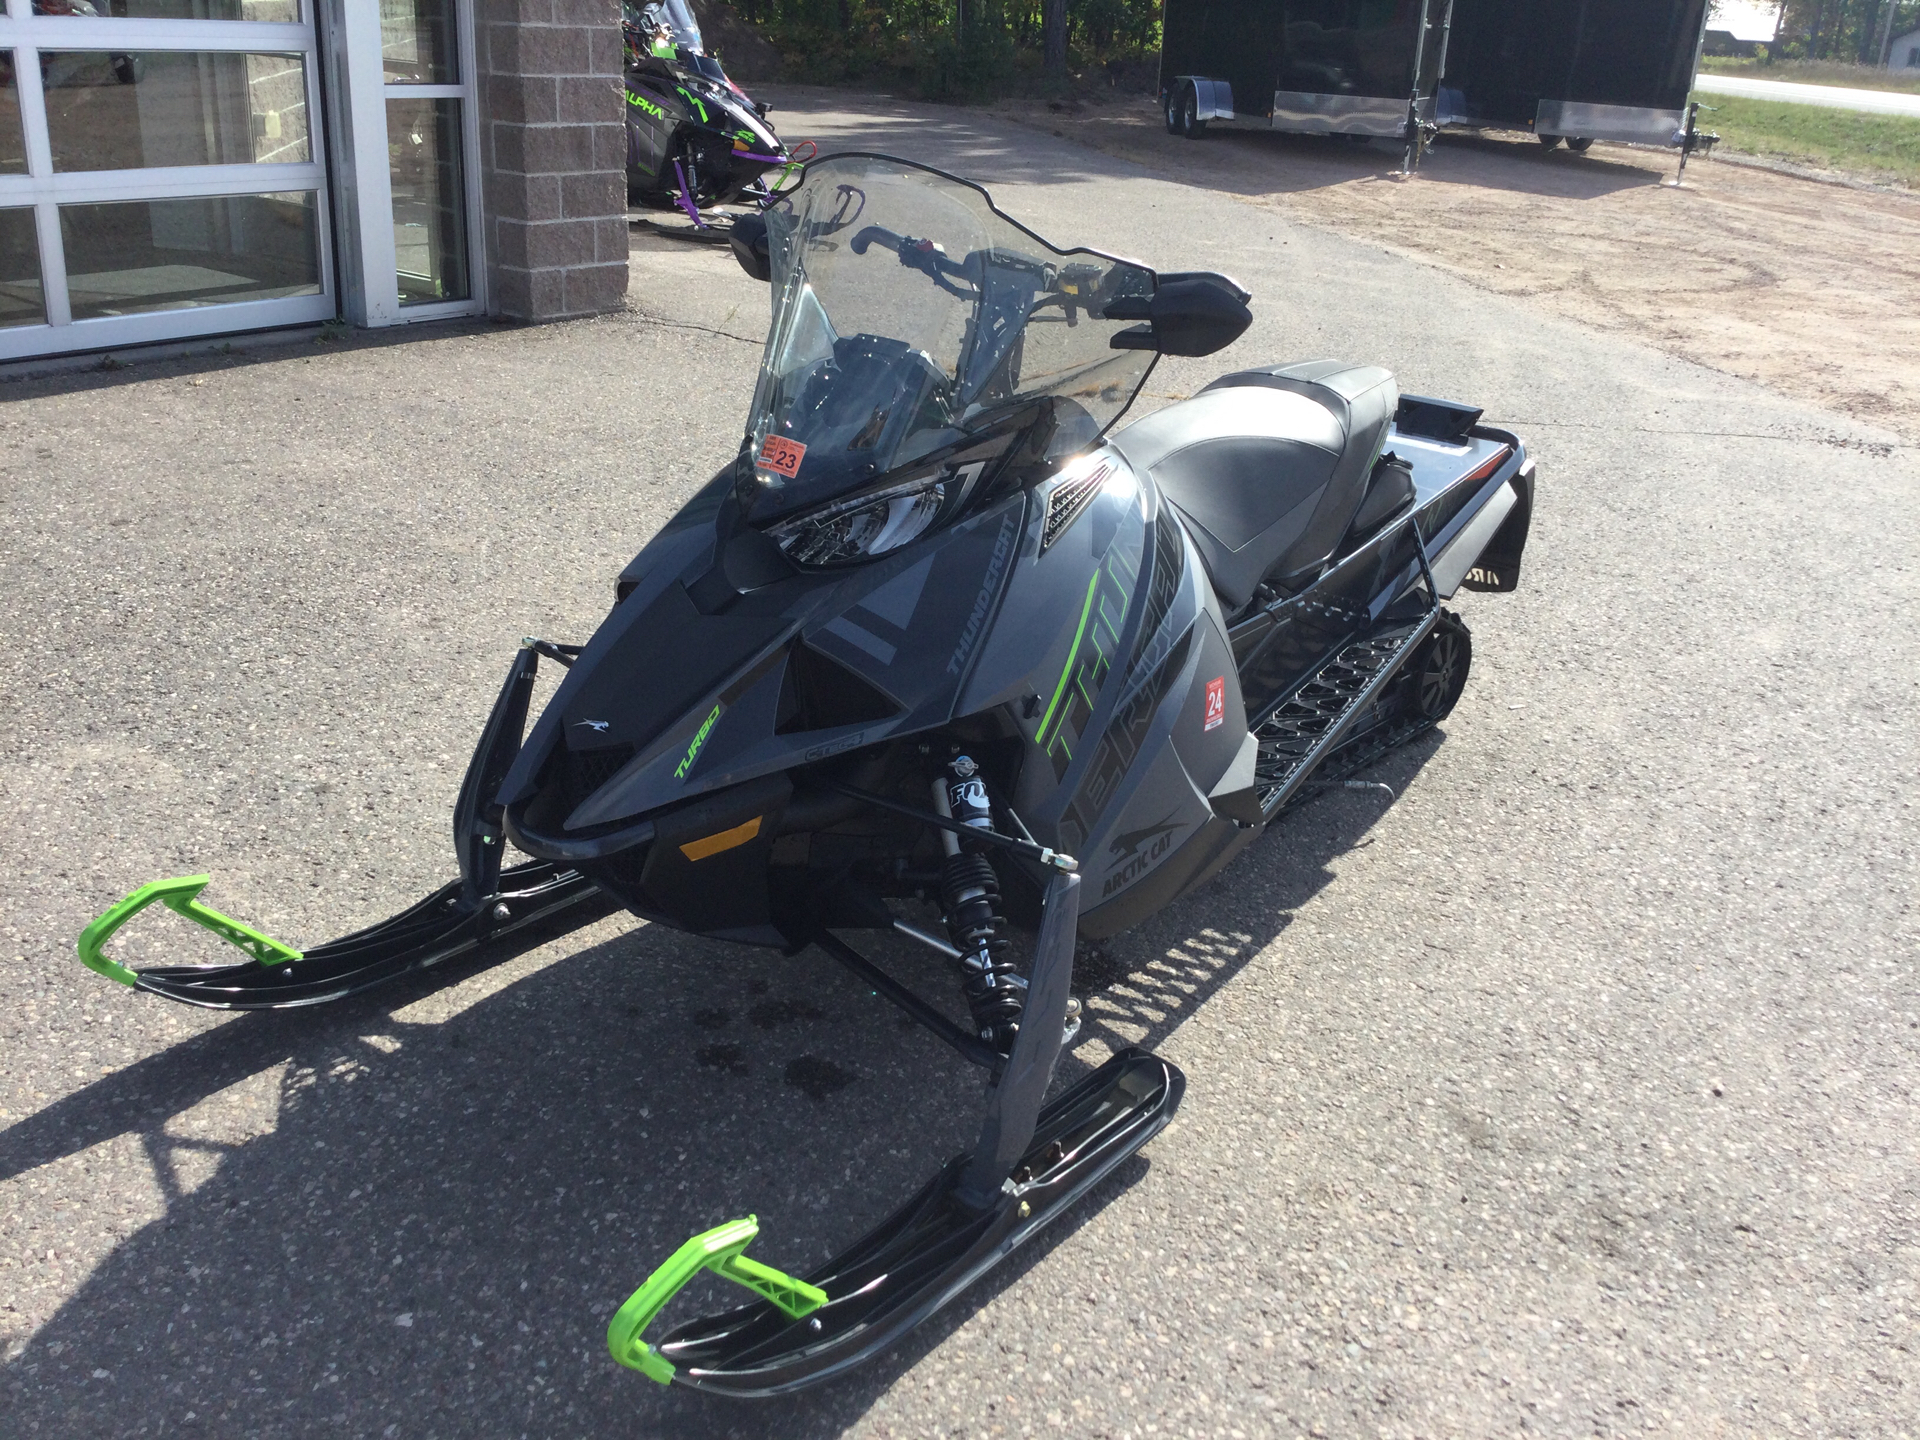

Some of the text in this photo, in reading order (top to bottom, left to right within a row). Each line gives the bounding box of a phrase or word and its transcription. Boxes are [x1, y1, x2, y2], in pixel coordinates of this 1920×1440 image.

[775, 450, 797, 469] 23
[946, 513, 1015, 675] THUNDERCAT
[1208, 687, 1222, 717] 24
[673, 704, 721, 779] TURBO
[1102, 830, 1173, 898] ARCTIC CAT
